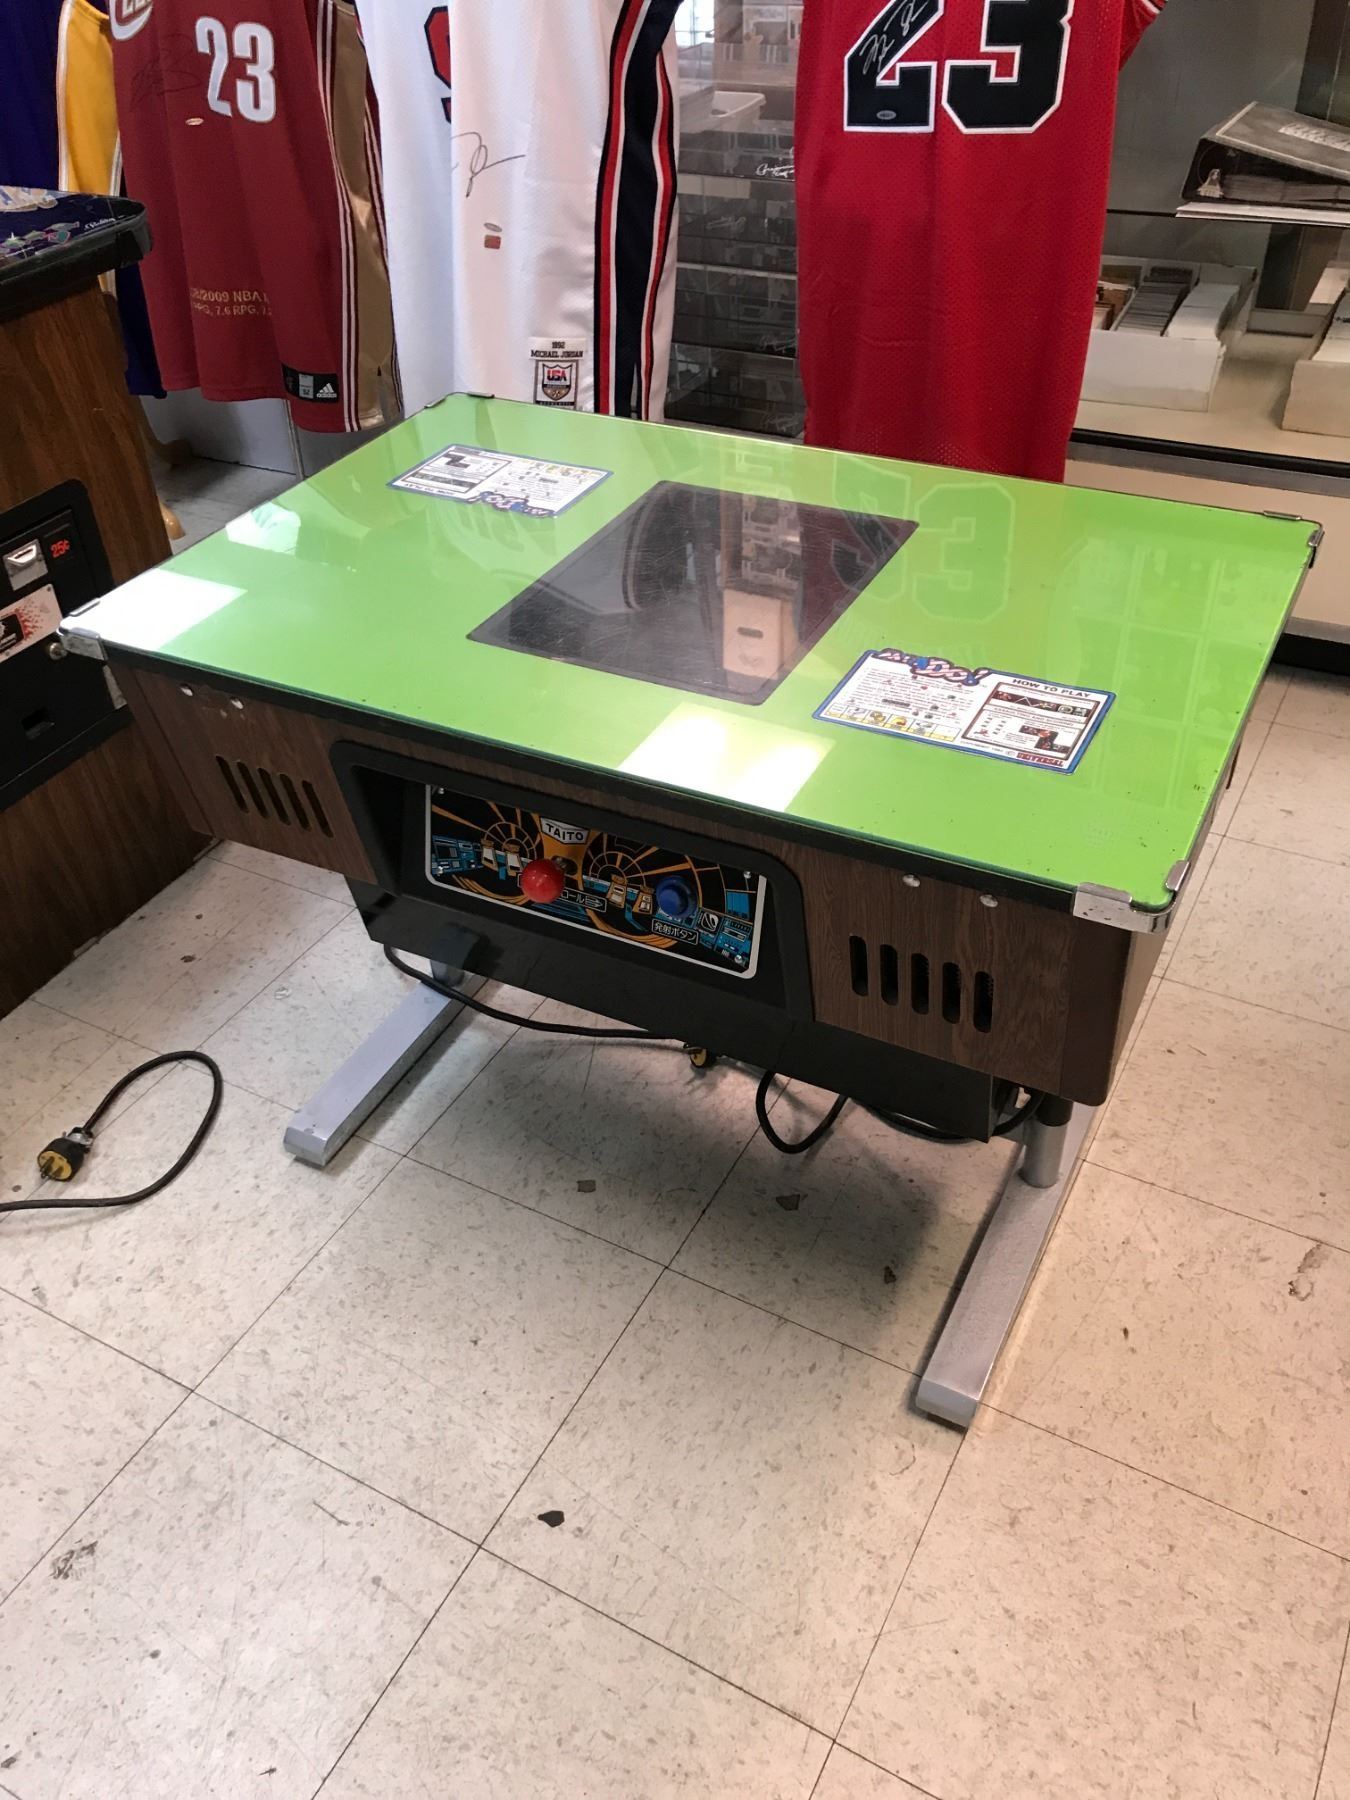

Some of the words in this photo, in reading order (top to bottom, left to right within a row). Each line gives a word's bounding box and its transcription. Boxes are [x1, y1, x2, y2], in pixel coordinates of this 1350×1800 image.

[195, 16, 276, 123] 23
[843, 0, 1074, 134] 23
[233, 290, 262, 302] NBA
[531, 350, 559, 358] MICHAEL
[547, 370, 567, 381] USA
[1013, 679, 1039, 688] HOW
[1061, 688, 1090, 698] PLAY
[545, 822, 584, 841] TAITO
[654, 921, 697, 941] 発射ボタン
